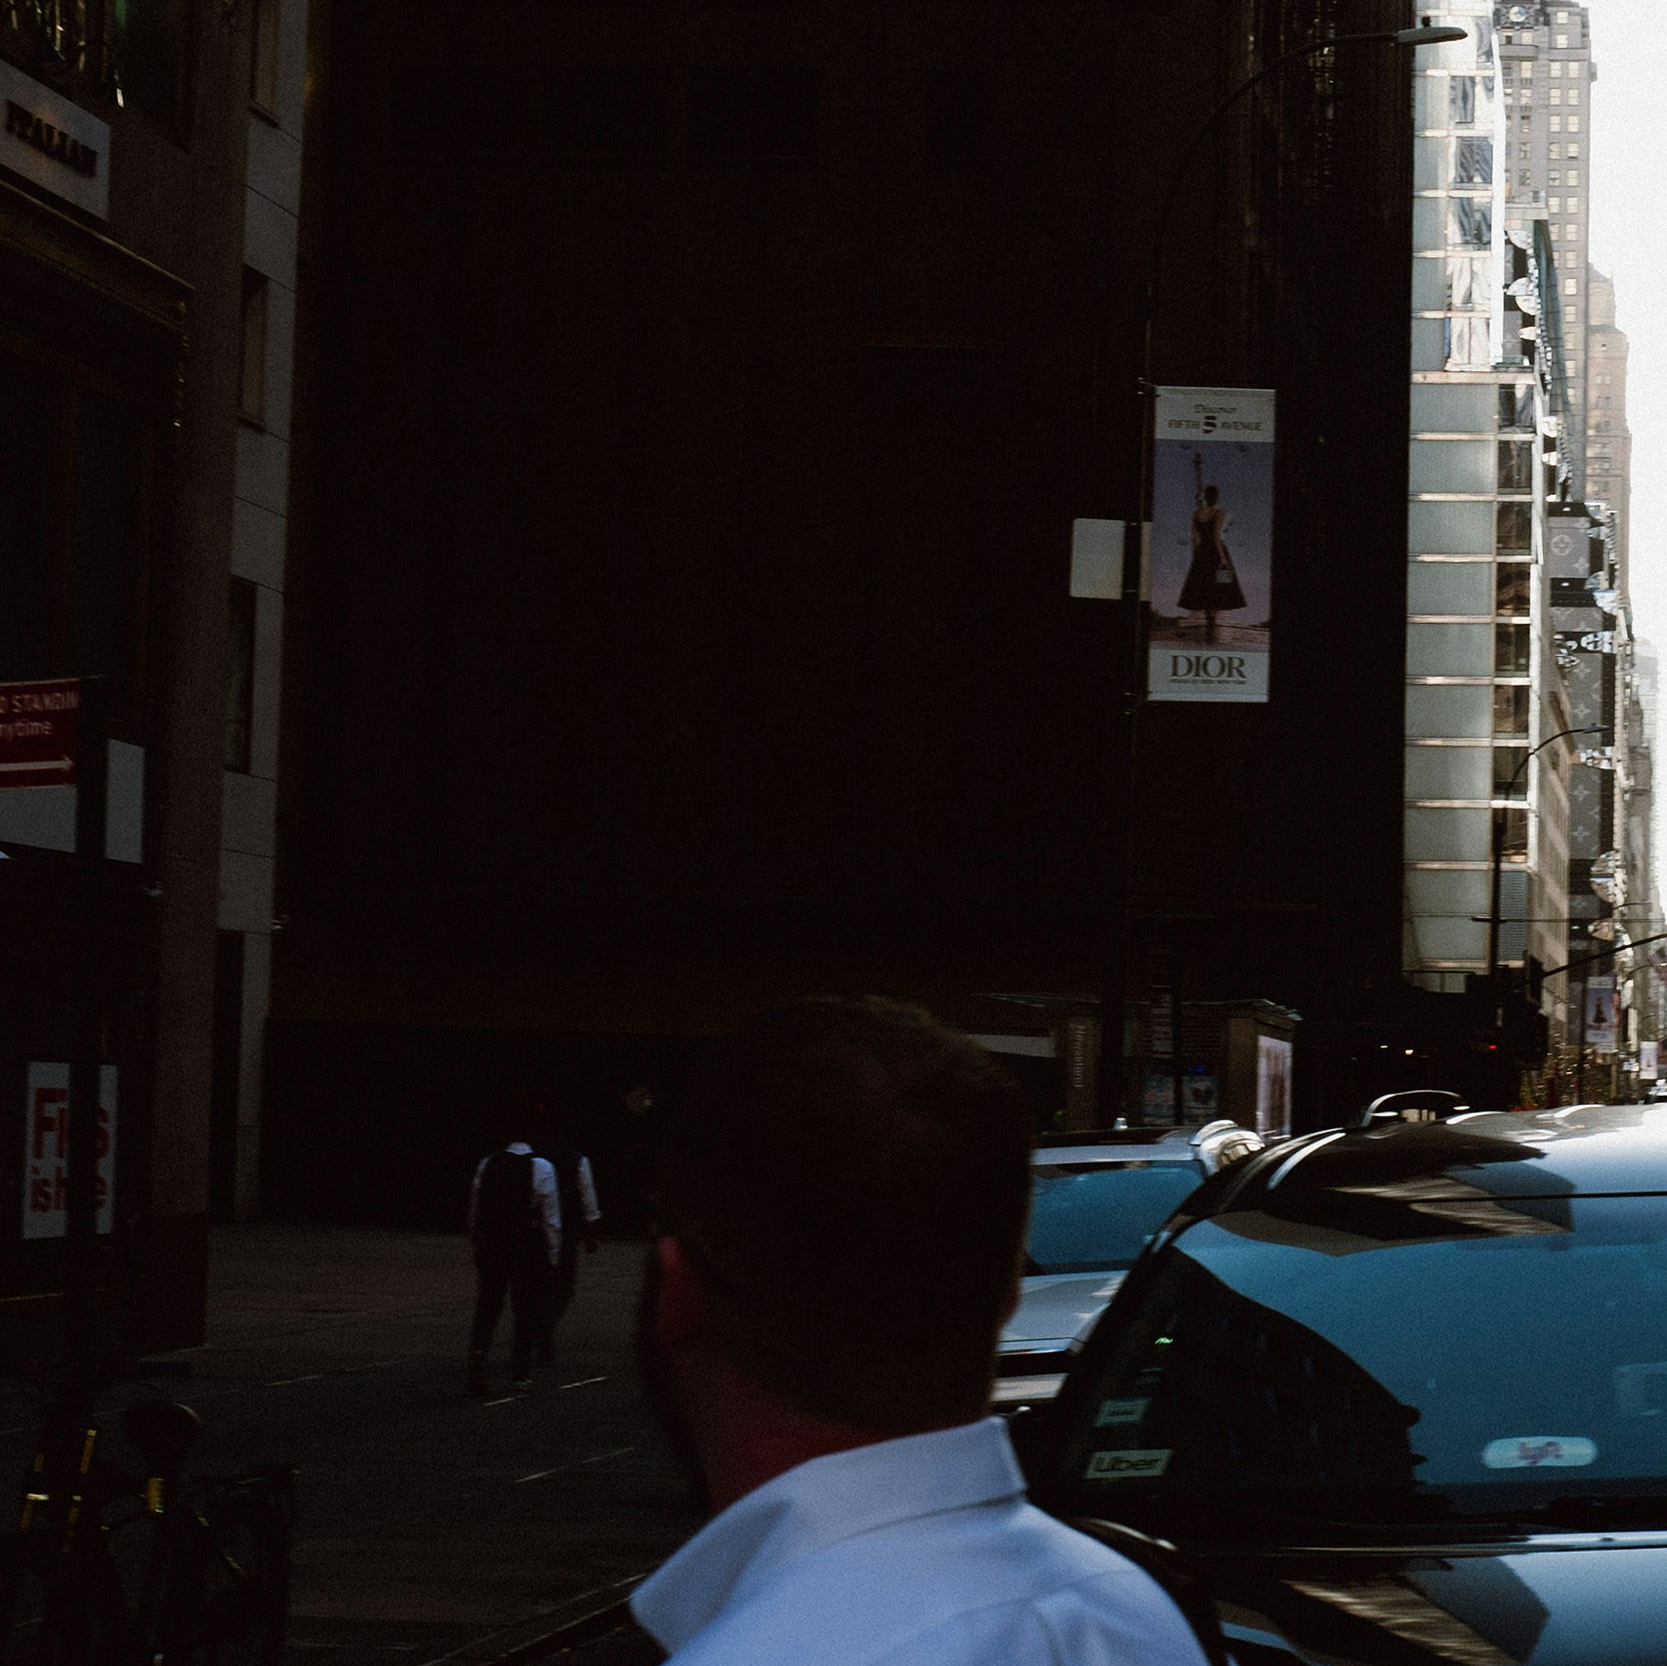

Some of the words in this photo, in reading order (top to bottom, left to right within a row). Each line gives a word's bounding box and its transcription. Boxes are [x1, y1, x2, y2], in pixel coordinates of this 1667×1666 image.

[1170, 654, 1247, 679] DIOR
[11, 691, 80, 713] STANDIN
[1094, 1456, 1163, 1472] Uber
